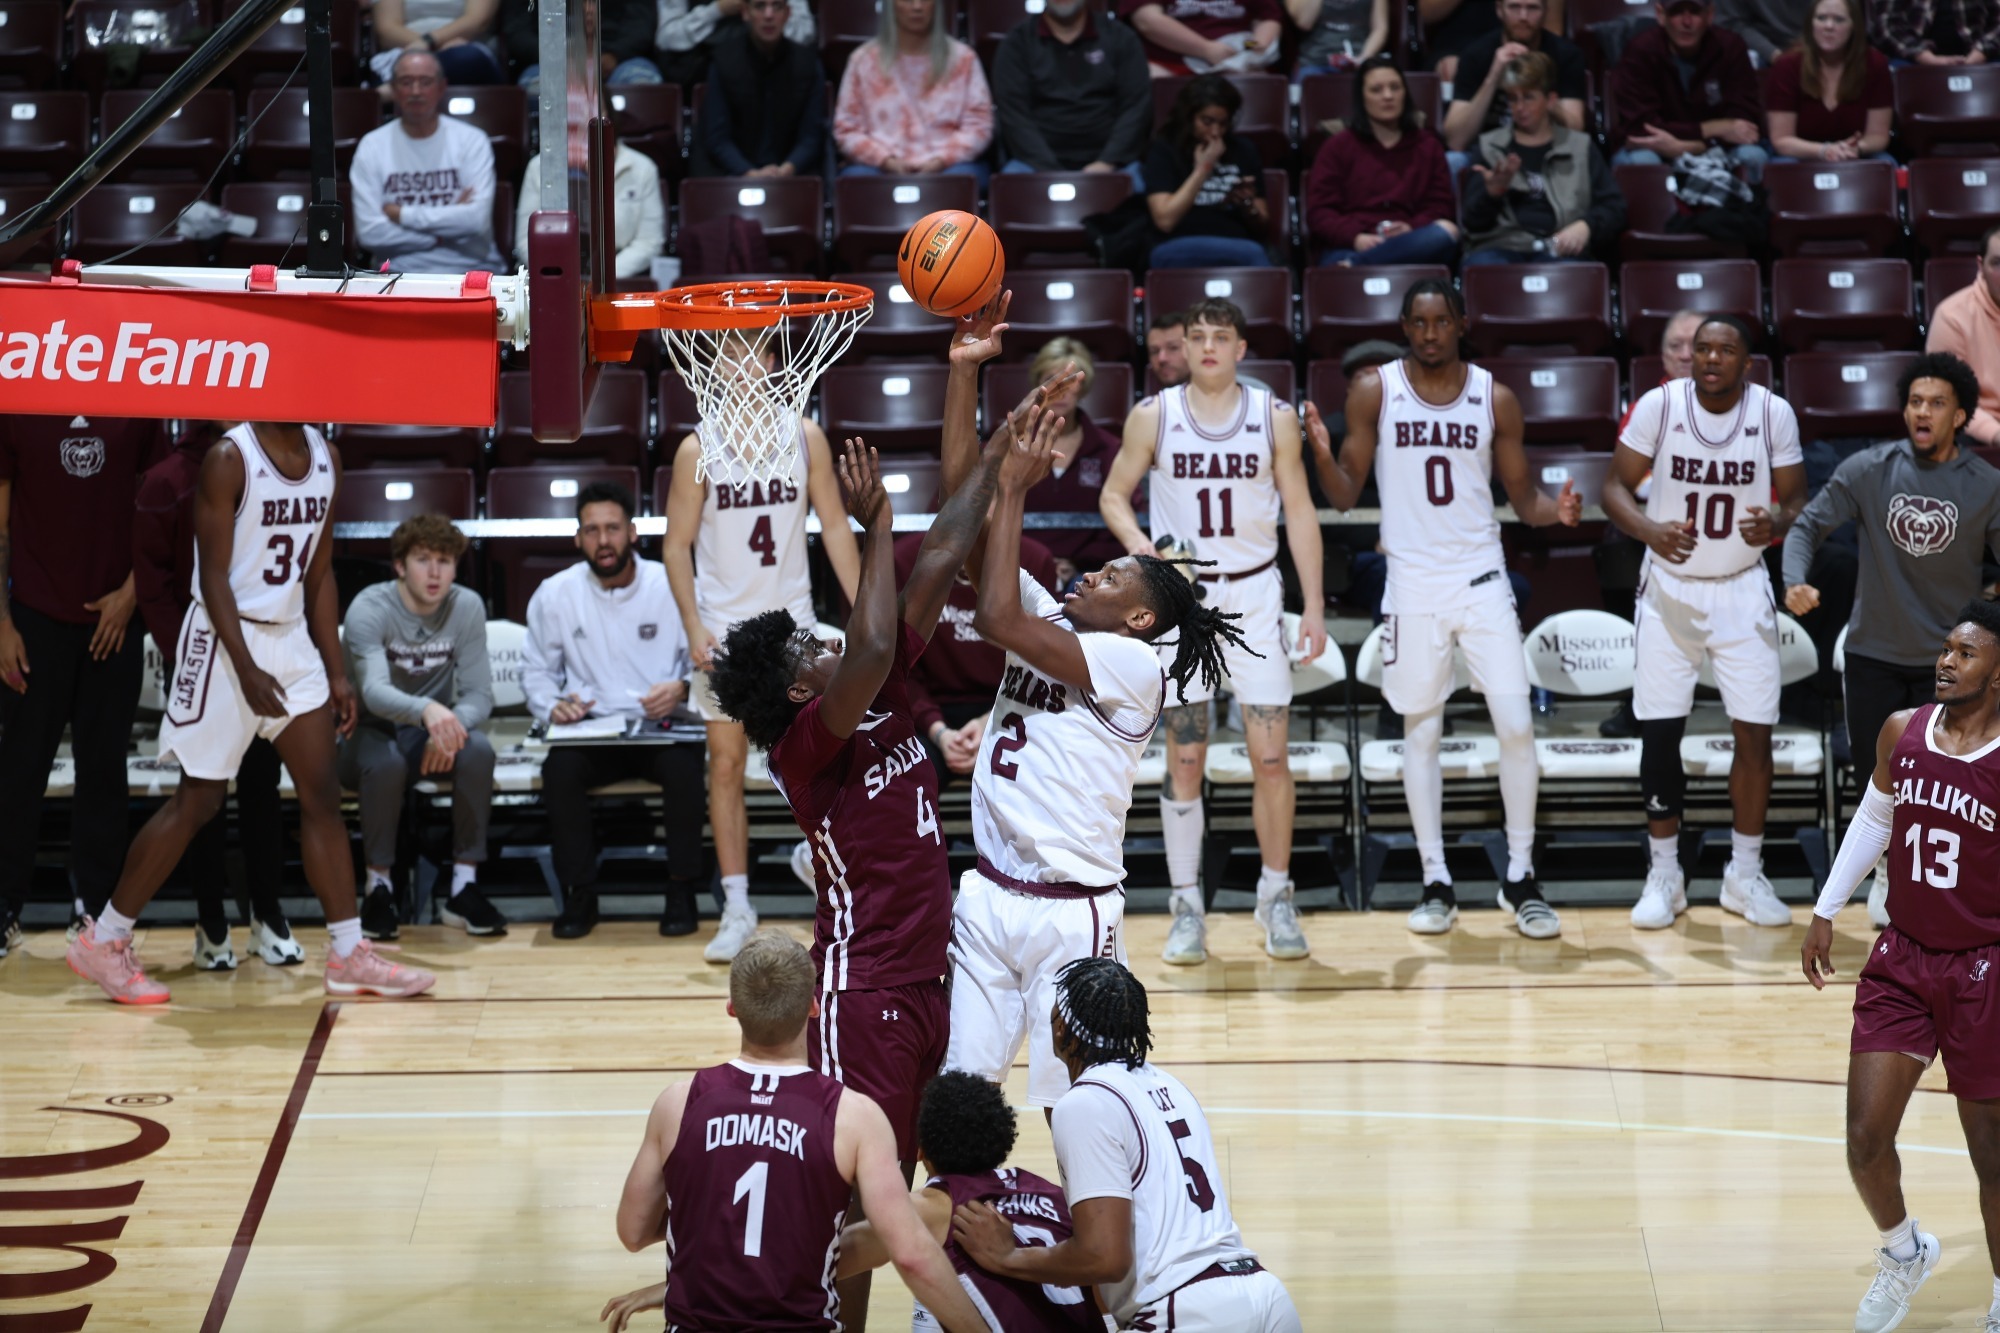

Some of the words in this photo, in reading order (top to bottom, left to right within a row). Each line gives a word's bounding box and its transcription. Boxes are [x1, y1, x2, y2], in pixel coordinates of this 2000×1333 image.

[0, 319, 104, 382] ate
[107, 322, 270, 388] Farm
[1394, 421, 1479, 450] BEARS
[1172, 453, 1259, 479] BEARS
[1425, 455, 1455, 506] 0
[1671, 455, 1756, 486] BEARS
[261, 496, 328, 527] BEARS
[716, 477, 797, 510] BEARS
[1196, 488, 1235, 538] 11
[1685, 492, 1735, 540] 10
[748, 515, 777, 567] 4
[1538, 633, 1635, 653] Missouri
[1560, 653, 1616, 673] State
[1001, 664, 1067, 714] EARS
[991, 712, 1028, 782] 2
[916, 786, 941, 846] 4
[1905, 822, 1961, 889] 13
[706, 1114, 807, 1161] DOMASK
[1165, 1118, 1216, 1213] 5
[732, 1161, 769, 1258] 1
